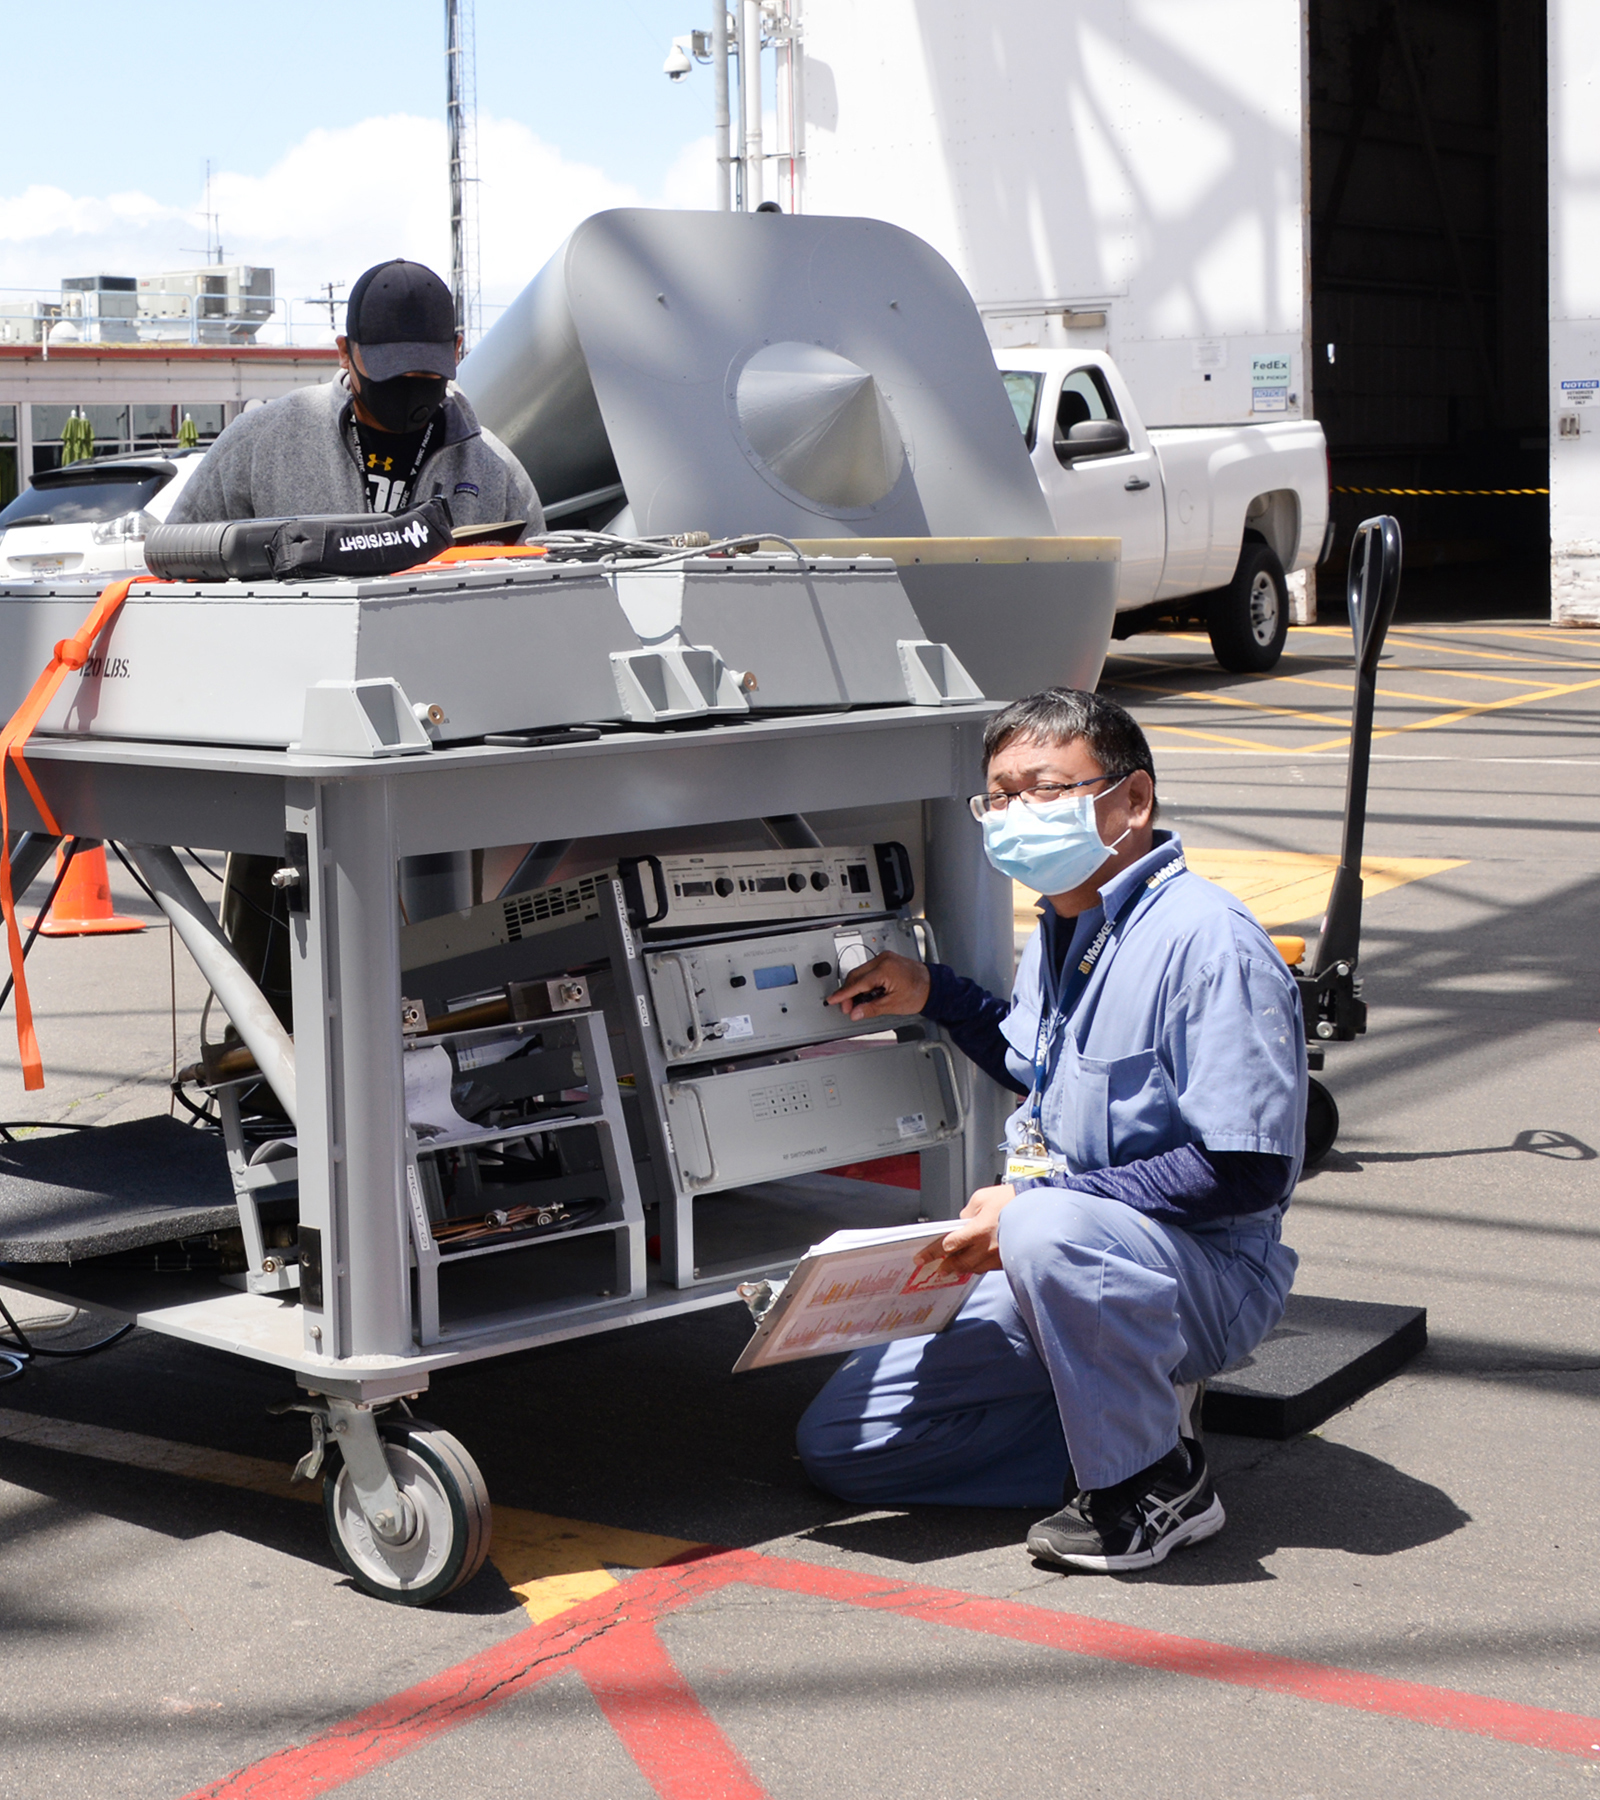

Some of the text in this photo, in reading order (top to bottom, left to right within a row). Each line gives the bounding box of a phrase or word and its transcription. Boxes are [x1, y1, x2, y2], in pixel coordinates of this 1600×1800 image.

[1252, 361, 1288, 370] FedEx
[1563, 381, 1598, 389] NOTICE
[421, 422, 434, 448] PACIFIC
[356, 445, 366, 472] PACIFIC
[339, 530, 403, 552] KEYSIGHT
[103, 658, 131, 678] LBS.
[638, 997, 649, 1025] ACU
[407, 1166, 424, 1227] PRC-117
